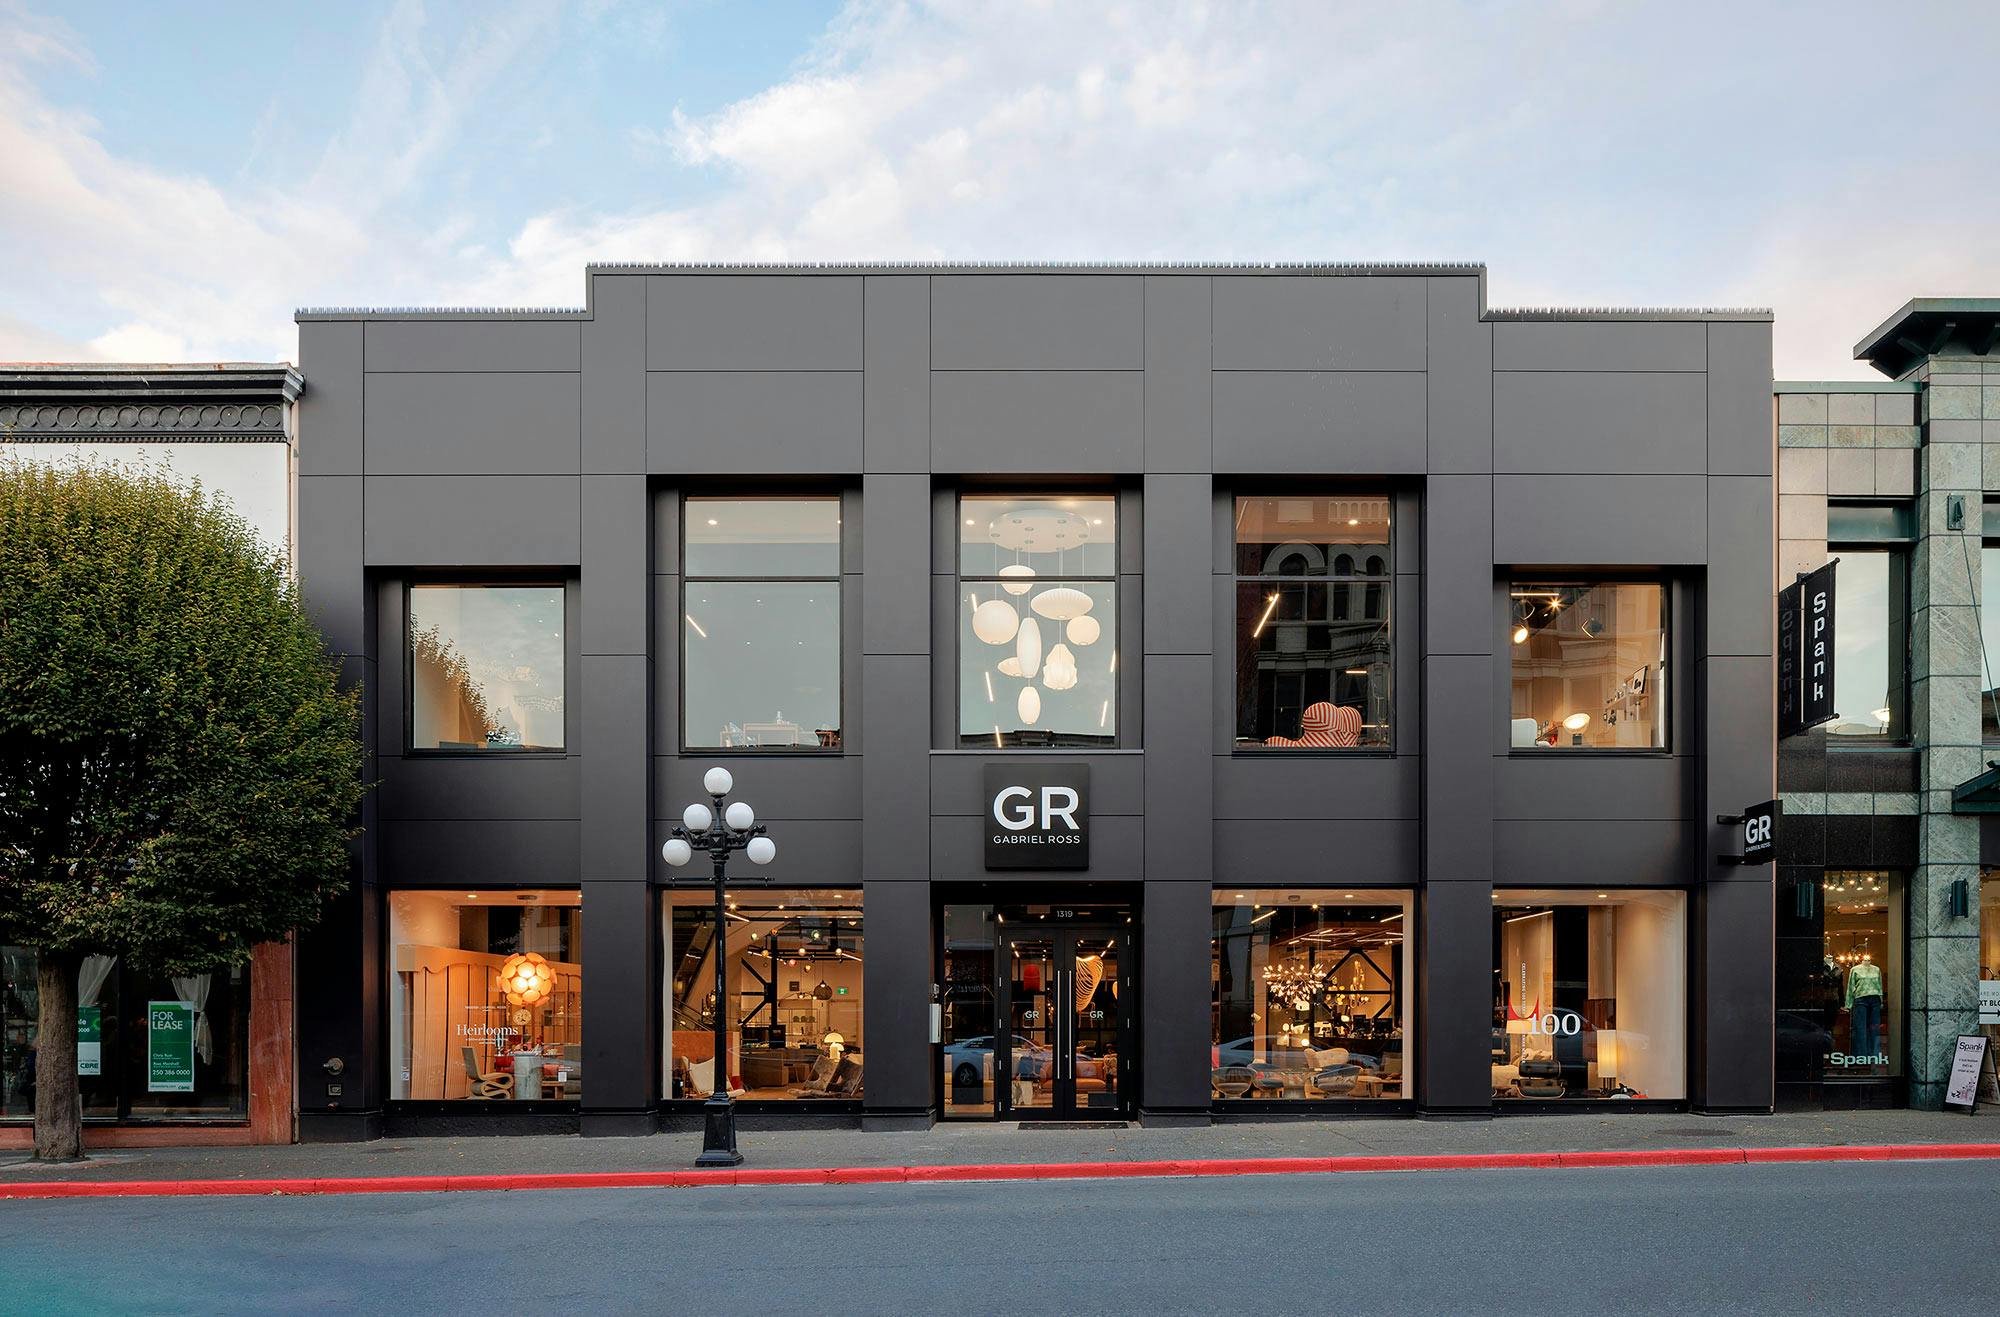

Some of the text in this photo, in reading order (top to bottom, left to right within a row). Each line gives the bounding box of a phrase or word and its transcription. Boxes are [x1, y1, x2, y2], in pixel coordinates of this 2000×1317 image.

[1813, 591, 1826, 702] Spank
[993, 786, 1080, 831] GR
[1745, 815, 1771, 844] GR
[993, 835, 1081, 844] GABRIEL ROSS
[1056, 910, 1073, 918] 1319
[152, 1011, 174, 1020] FOR
[1025, 1010, 1040, 1019] GR
[1089, 1010, 1104, 1019] GR
[152, 1020, 183, 1030] LEASE
[456, 1023, 519, 1036] Heirlooms
[1530, 1013, 1580, 1035] 100
[1959, 1041, 1983, 1052] Spank
[1830, 1052, 1889, 1068] Spank
